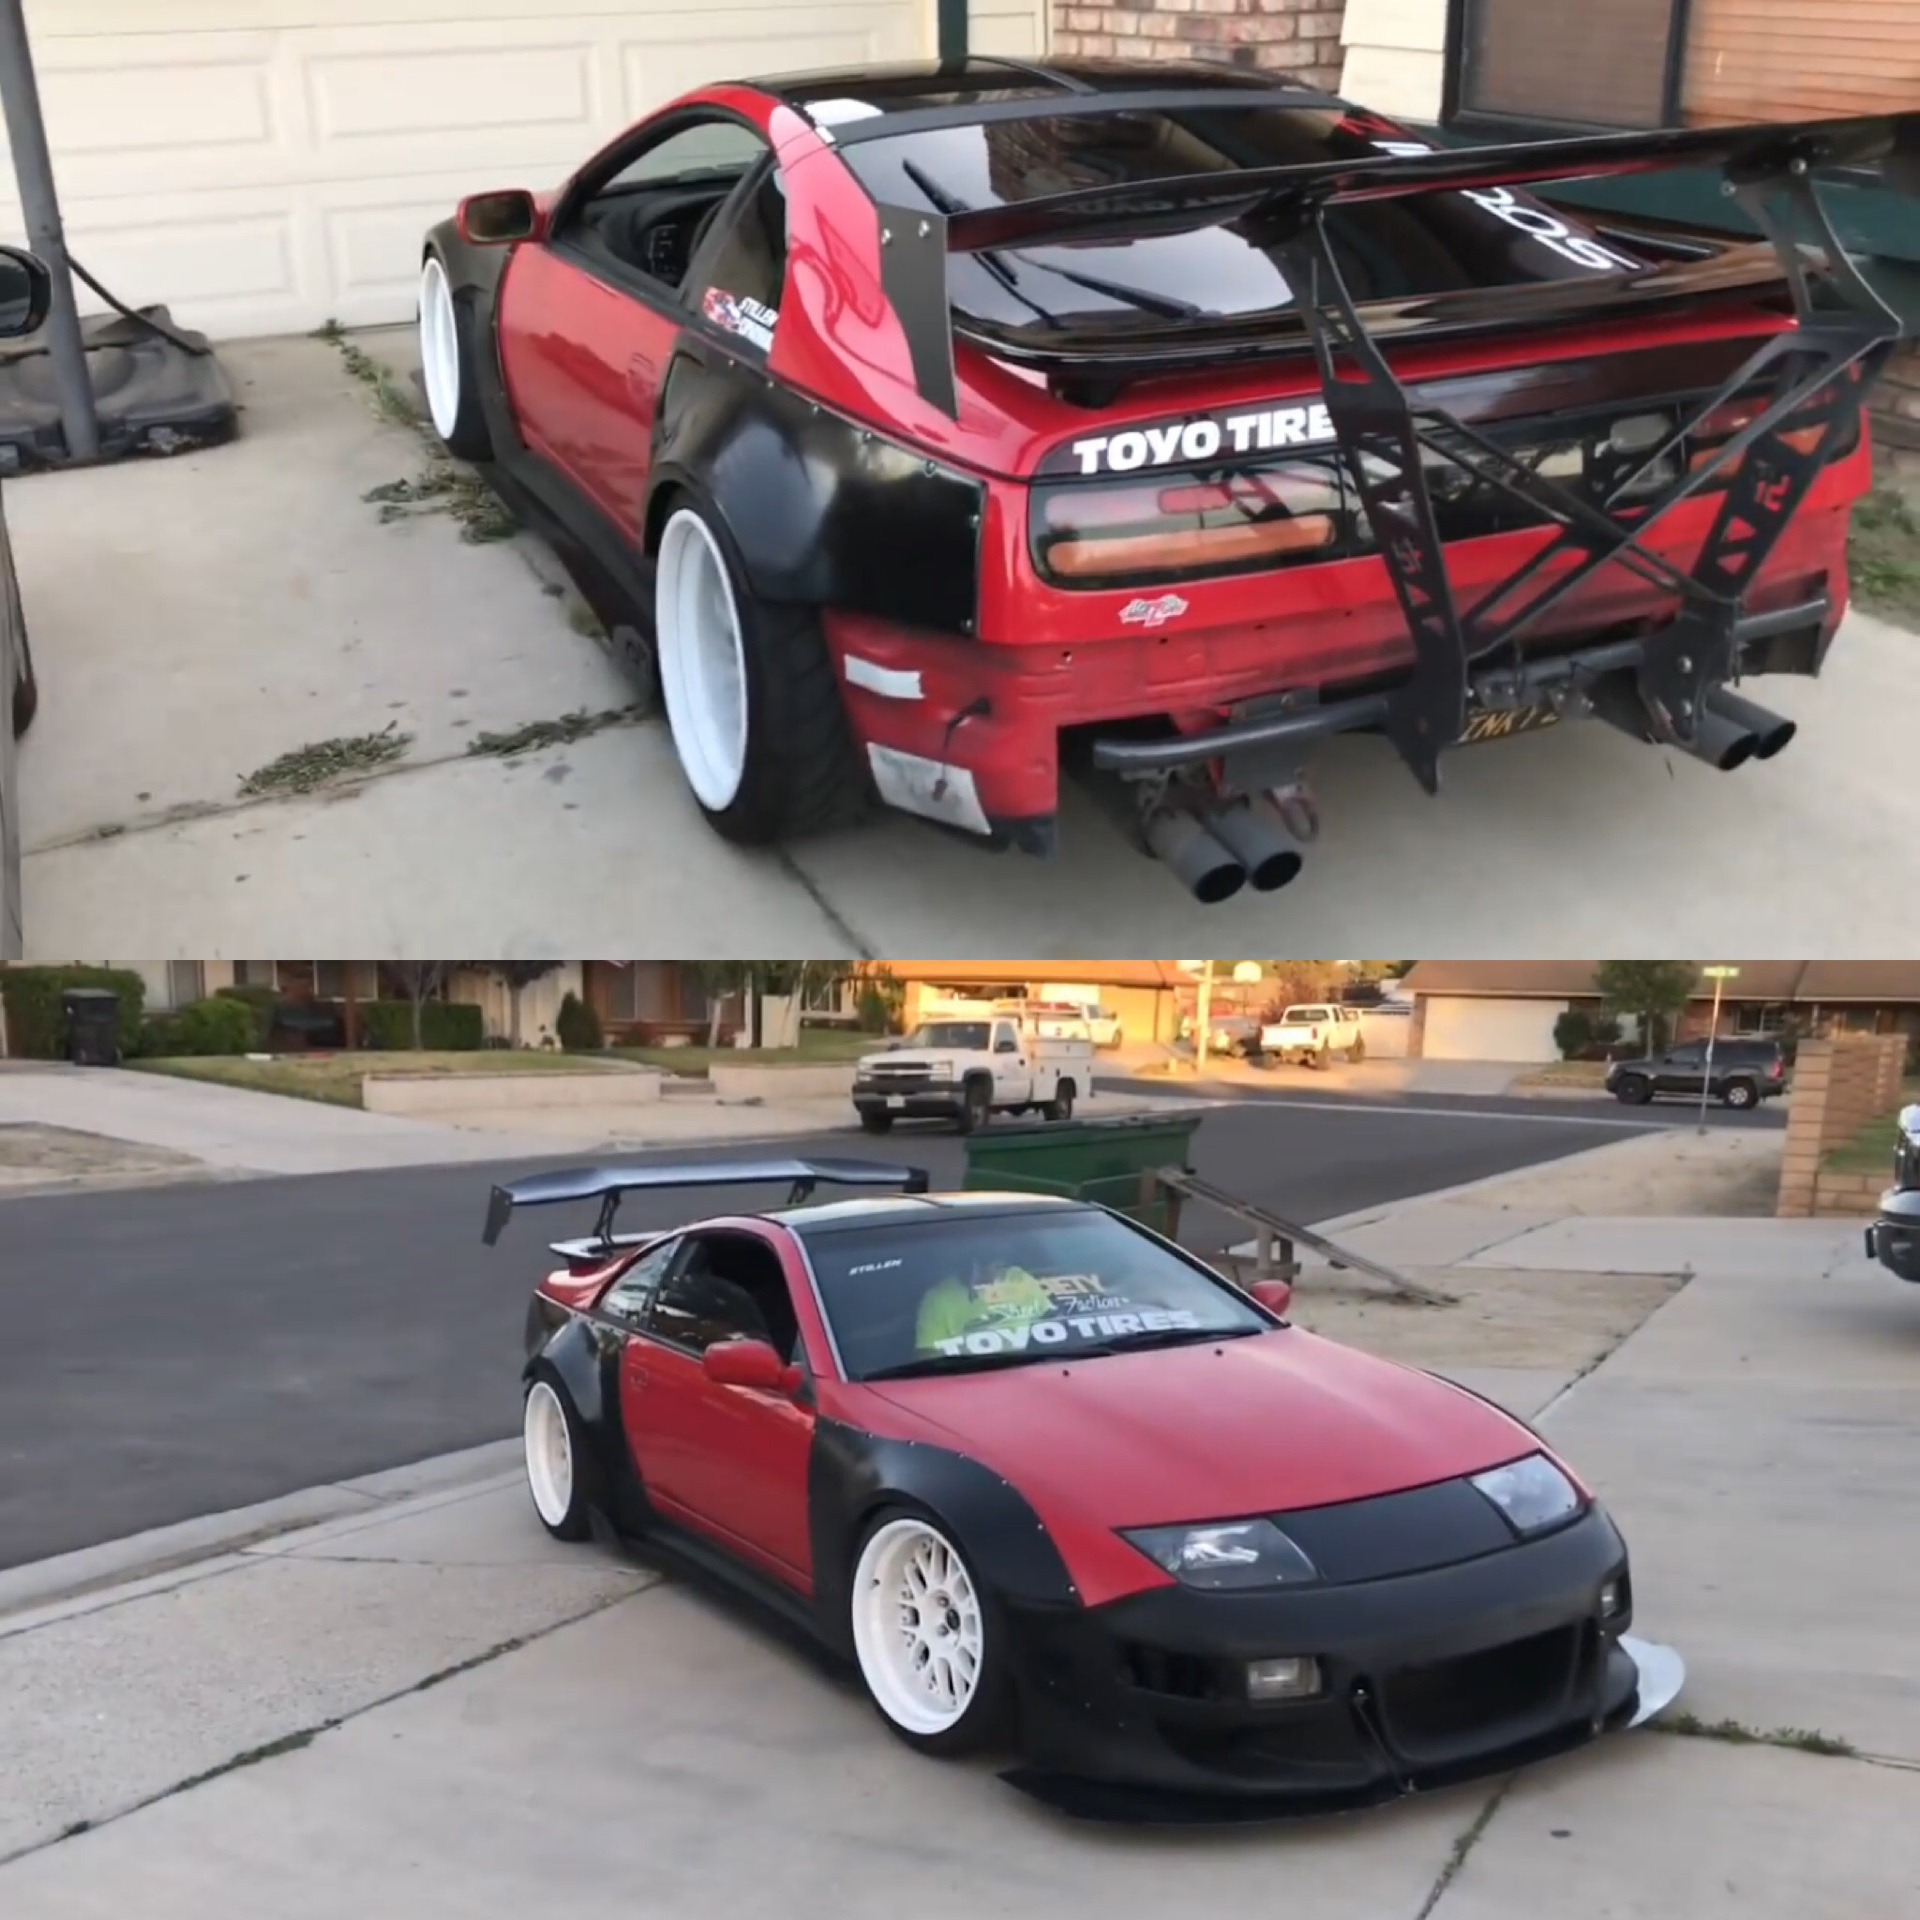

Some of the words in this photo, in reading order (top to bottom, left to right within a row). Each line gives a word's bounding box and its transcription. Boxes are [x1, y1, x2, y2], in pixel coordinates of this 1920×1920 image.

[1073, 420, 1221, 474] TOYO
[933, 1321, 1068, 1357] TOYO
[1068, 1310, 1200, 1340] TIRES
